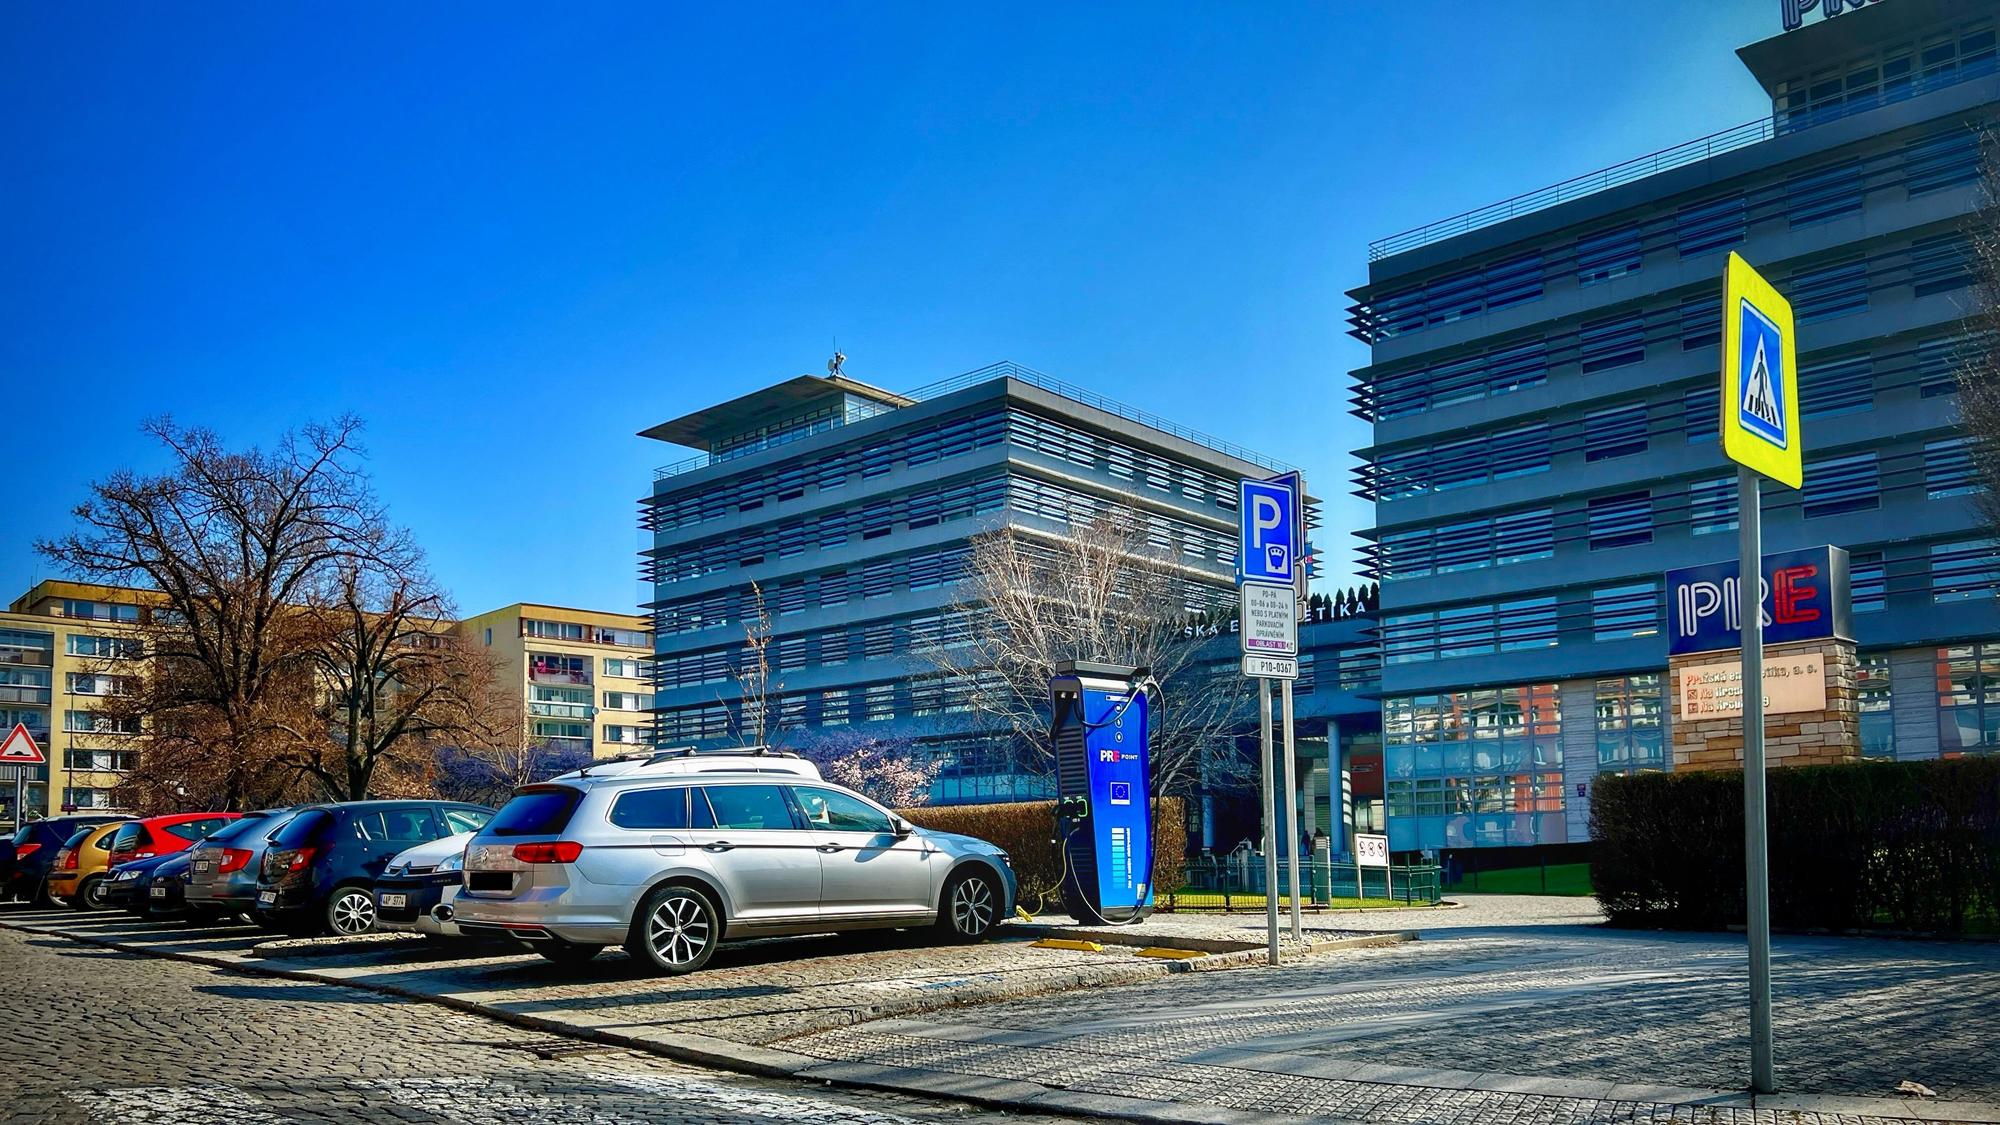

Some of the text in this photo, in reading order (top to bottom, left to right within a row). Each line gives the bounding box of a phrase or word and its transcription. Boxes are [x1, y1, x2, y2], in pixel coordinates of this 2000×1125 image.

[1253, 494, 1281, 549] P
[1677, 564, 1821, 637] PRE
[1256, 640, 1276, 648] OBLAST
[1260, 661, 1292, 674] P10-0367
[1700, 688, 1714, 699] Na
[1700, 702, 1714, 714] Na
[1100, 749, 1120, 763] PRE
